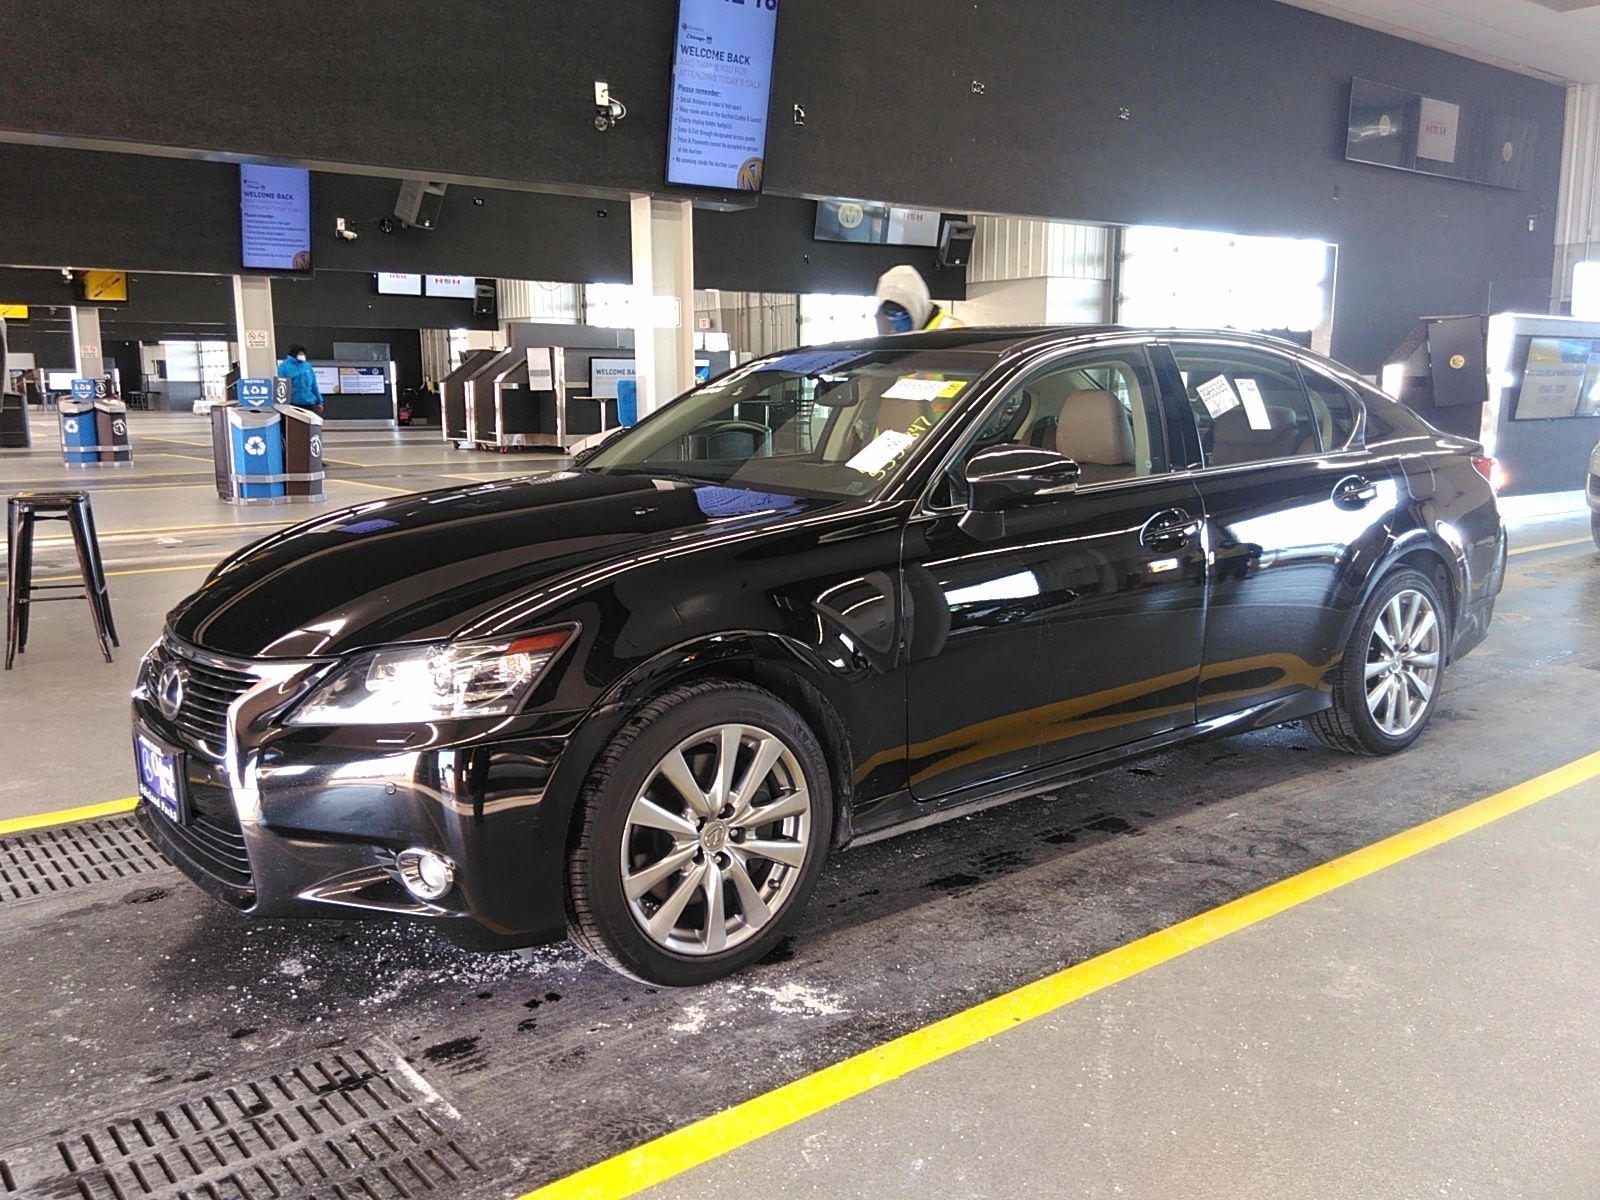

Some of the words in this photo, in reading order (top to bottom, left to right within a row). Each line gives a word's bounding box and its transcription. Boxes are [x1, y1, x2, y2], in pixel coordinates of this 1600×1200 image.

[680, 44, 725, 61] WELCOME
[727, 52, 751, 65] BACK
[677, 84, 694, 93] Please
[243, 191, 275, 199] WELCOME
[596, 368, 626, 376] WELCOME
